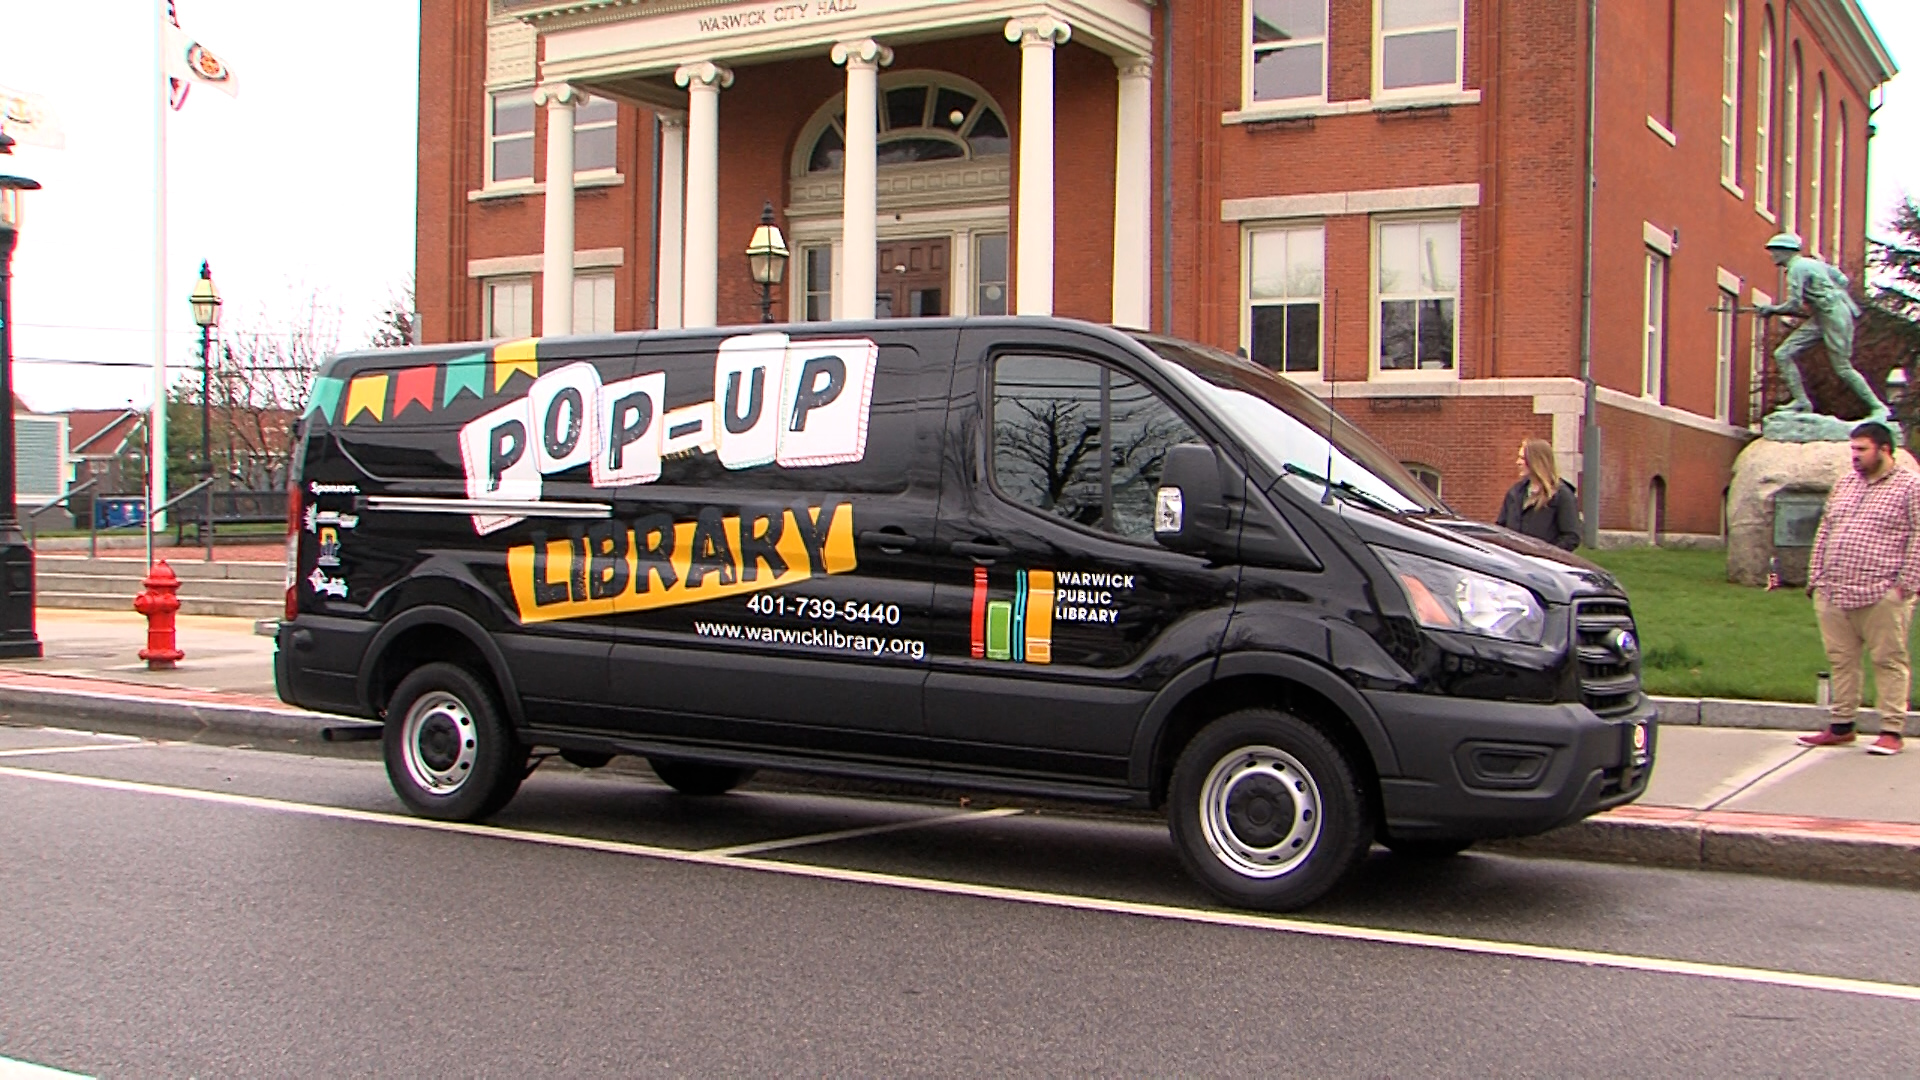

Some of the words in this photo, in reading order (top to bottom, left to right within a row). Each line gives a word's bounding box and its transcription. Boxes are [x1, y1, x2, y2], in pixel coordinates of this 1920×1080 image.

[699, 10, 767, 31] WARWICK
[774, 3, 808, 22] CITY
[817, 0, 857, 15] HALL
[486, 355, 847, 493] POP-UP
[531, 494, 844, 609] LIBRARY
[1056, 571, 1135, 588] WARWICK
[747, 594, 901, 625] 401-739-5440
[1056, 588, 1112, 605] PUBLIC
[1055, 606, 1119, 623] LIBRARY
[694, 621, 925, 660] www.warwicklibrary.org
